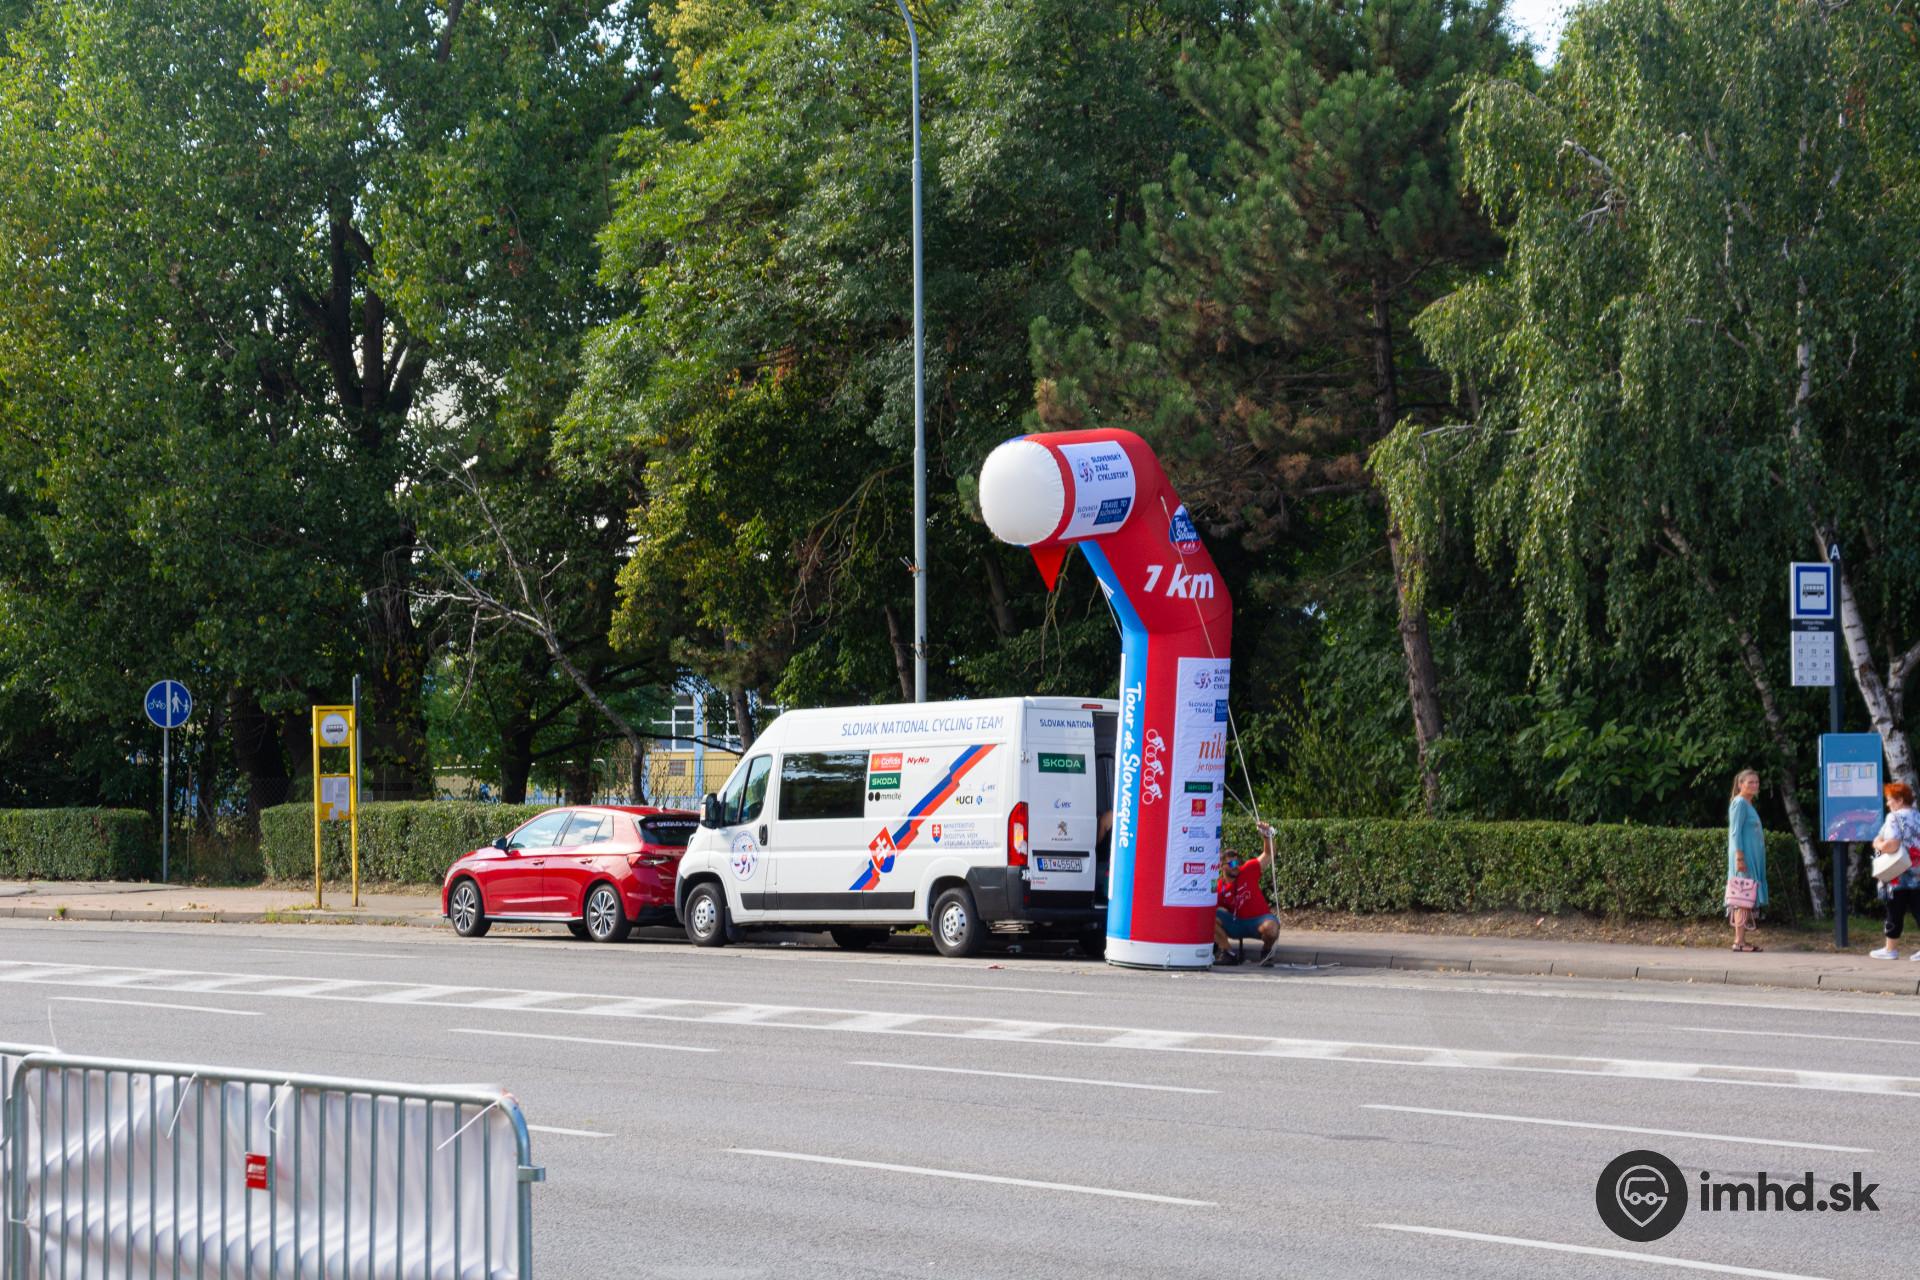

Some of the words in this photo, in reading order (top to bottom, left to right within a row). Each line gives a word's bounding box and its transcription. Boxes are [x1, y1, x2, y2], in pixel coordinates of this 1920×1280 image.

[1830, 543, 1841, 560] A
[1143, 564, 1163, 593] 1
[1165, 563, 1215, 599] km
[1124, 681, 1142, 730] Tour
[841, 721, 879, 737] SLOVAK
[880, 719, 929, 735] NATIONAL
[932, 717, 973, 732] CYCLING
[976, 715, 1004, 730] TEAM
[1040, 719, 1065, 728] SLOVAK
[1123, 729, 1136, 750] de
[960, 795, 973, 805] UCI
[1117, 752, 1141, 849] Slovaquie
